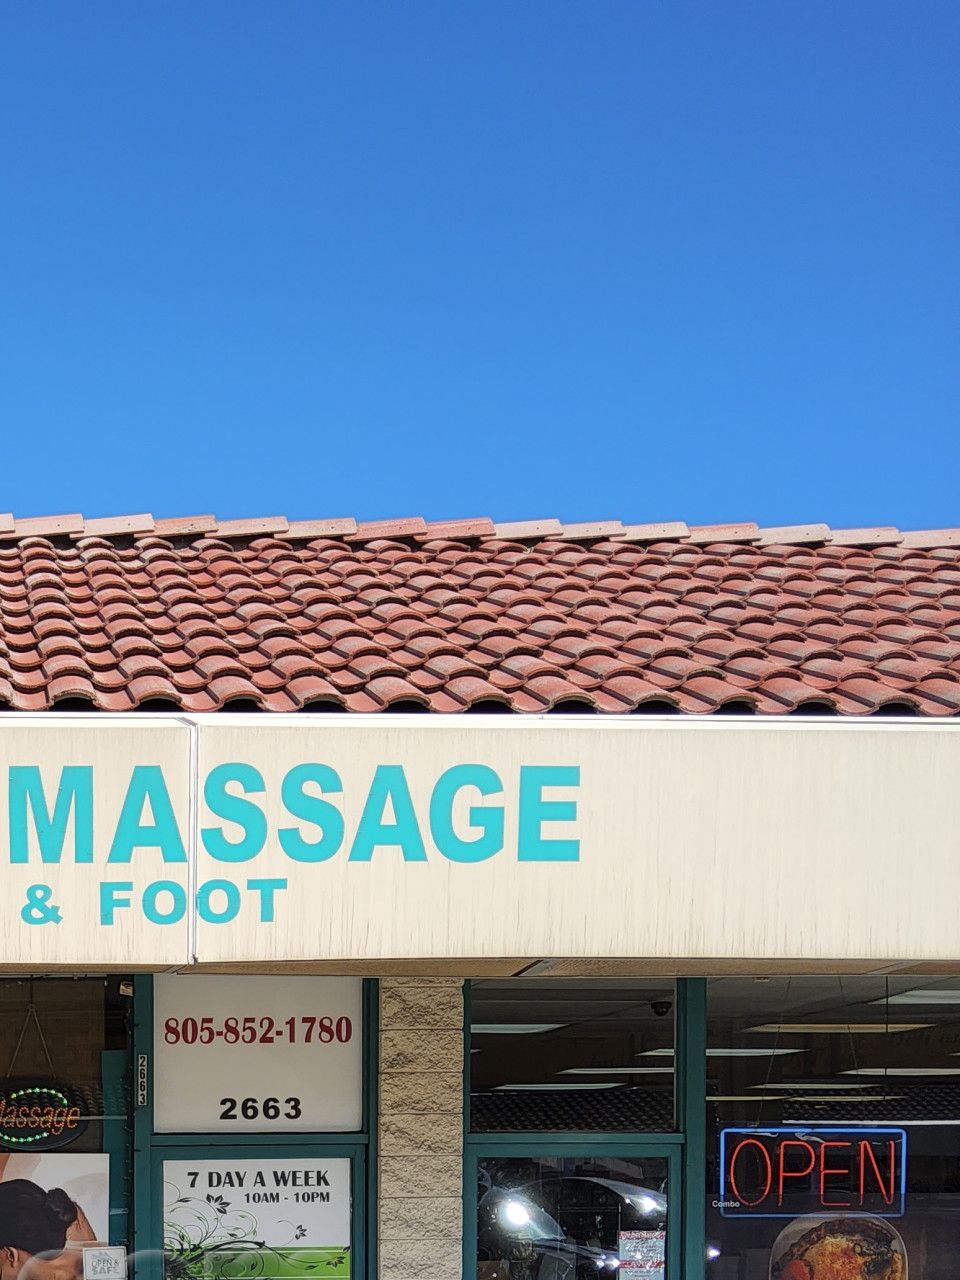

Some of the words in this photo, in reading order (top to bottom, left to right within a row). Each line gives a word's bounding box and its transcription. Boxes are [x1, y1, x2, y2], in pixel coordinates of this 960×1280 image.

[8, 762, 581, 864] MASSAGE
[20, 883, 64, 925] &
[99, 877, 288, 926] FOOT
[164, 1016, 352, 1044] 805-852-1780
[219, 1097, 302, 1120] 2663
[187, 1171, 200, 1188] 7
[207, 1171, 247, 1188] DAY
[253, 1170, 266, 1188] A
[272, 1170, 331, 1187] WEEK
[728, 1137, 896, 1207] OPEN
[244, 1191, 280, 1204] 10AM
[293, 1191, 330, 1203] 10PM
[711, 1199, 741, 1209] Combo
